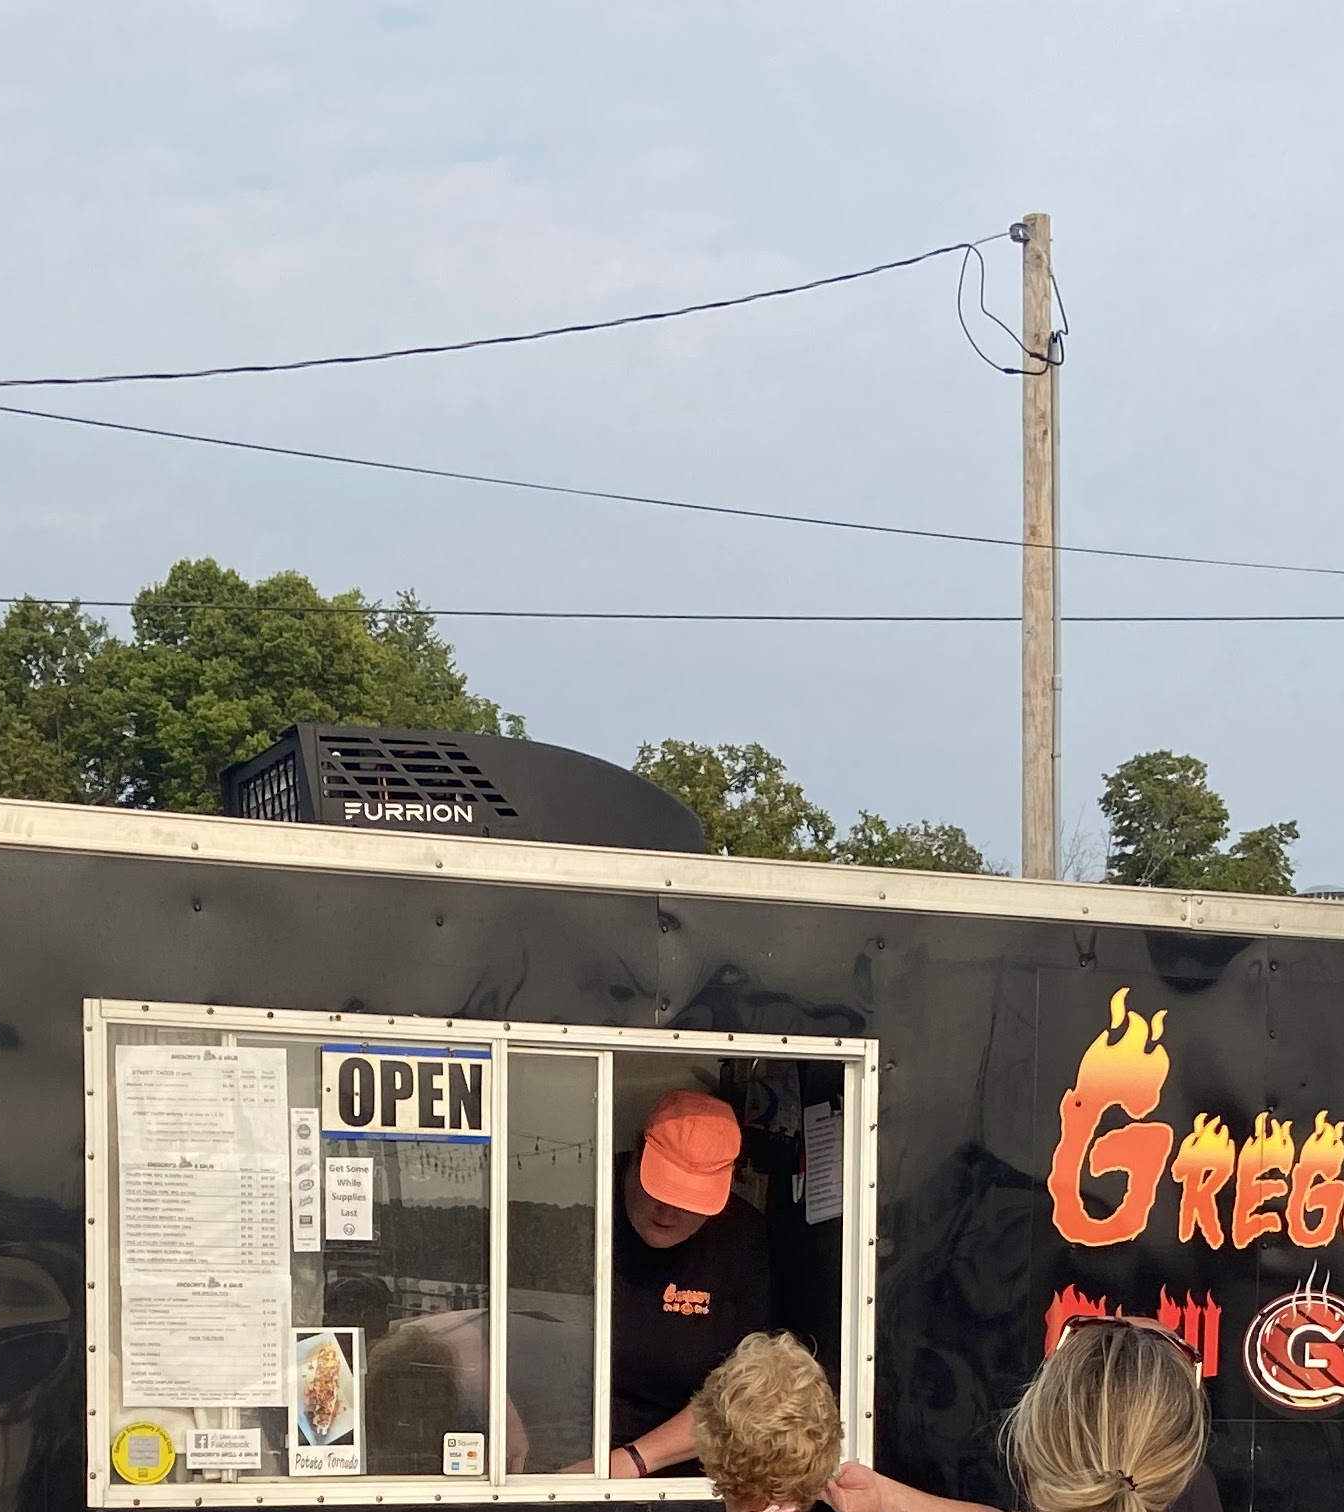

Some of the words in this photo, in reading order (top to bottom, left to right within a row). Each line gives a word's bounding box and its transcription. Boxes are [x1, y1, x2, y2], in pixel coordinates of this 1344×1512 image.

[344, 802, 474, 824] FURRION
[338, 1057, 483, 1130] OPEN
[329, 1164, 344, 1173] Get
[346, 1164, 369, 1173] Some
[337, 1179, 362, 1187] While
[331, 1193, 366, 1202] Supplies
[340, 1209, 358, 1217] Last
[211, 1441, 250, 1449] Facebook
[457, 1439, 479, 1448] Square
[295, 1452, 323, 1471] Potato
[327, 1452, 359, 1470] Tornado
